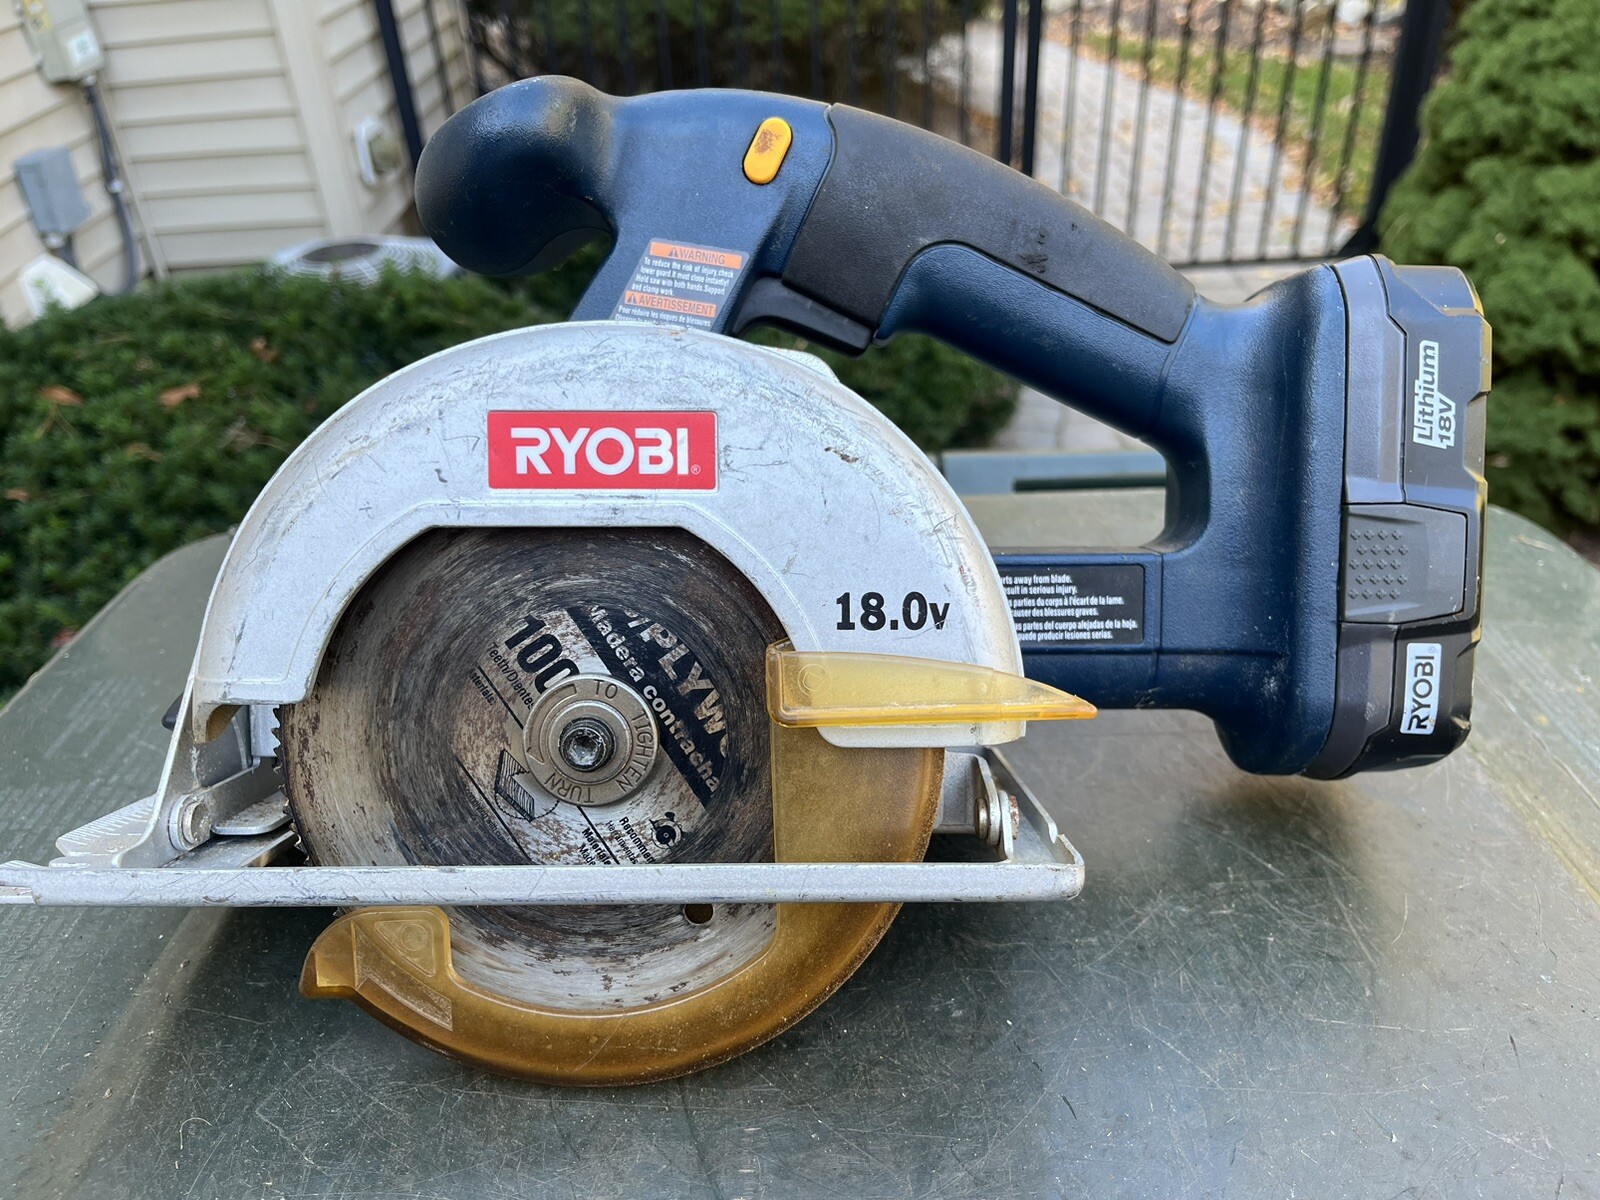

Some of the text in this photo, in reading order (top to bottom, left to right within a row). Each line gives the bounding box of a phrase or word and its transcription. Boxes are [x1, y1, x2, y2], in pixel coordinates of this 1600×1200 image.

[644, 256, 651, 266] To
[652, 257, 670, 269] reduce
[672, 261, 681, 270] the
[683, 262, 693, 272] risk
[694, 264, 701, 273] of
[680, 248, 726, 265] WARNING
[641, 265, 655, 276] lower
[677, 271, 690, 280] must
[691, 273, 705, 283] close
[650, 276, 660, 285] saw
[662, 278, 673, 287] with
[674, 279, 686, 289] both
[631, 283, 642, 292] and
[643, 284, 659, 295] clamp
[618, 305, 631, 315] Pour
[640, 293, 714, 315] AVERTISSEMENT
[1417, 345, 1436, 441] Lithium
[1438, 397, 1453, 443] 18V
[510, 427, 689, 475] RYOBI
[1013, 576, 1032, 586] away
[1033, 574, 1050, 584] from
[1021, 585, 1028, 595] in
[1029, 584, 1055, 595] serious
[1013, 597, 1036, 609] parties
[1036, 597, 1045, 607] du
[1045, 597, 1063, 608] corps
[1090, 595, 1098, 606] de
[1099, 595, 1106, 606] la
[1032, 607, 1044, 617] des
[1044, 607, 1075, 617] blessures
[1022, 621, 1043, 632] partes
[1044, 620, 1054, 631] del
[1054, 621, 1077, 632] cuerpo
[1077, 619, 1104, 631] alejadas
[1105, 619, 1113, 630] de
[1114, 618, 1121, 629] la
[587, 604, 646, 683] Madera
[1037, 630, 1064, 642] producir
[1064, 630, 1091, 640] lesiones
[1407, 655, 1435, 731] RYOBI
[544, 679, 654, 803] TURN TO TIGHTEN
